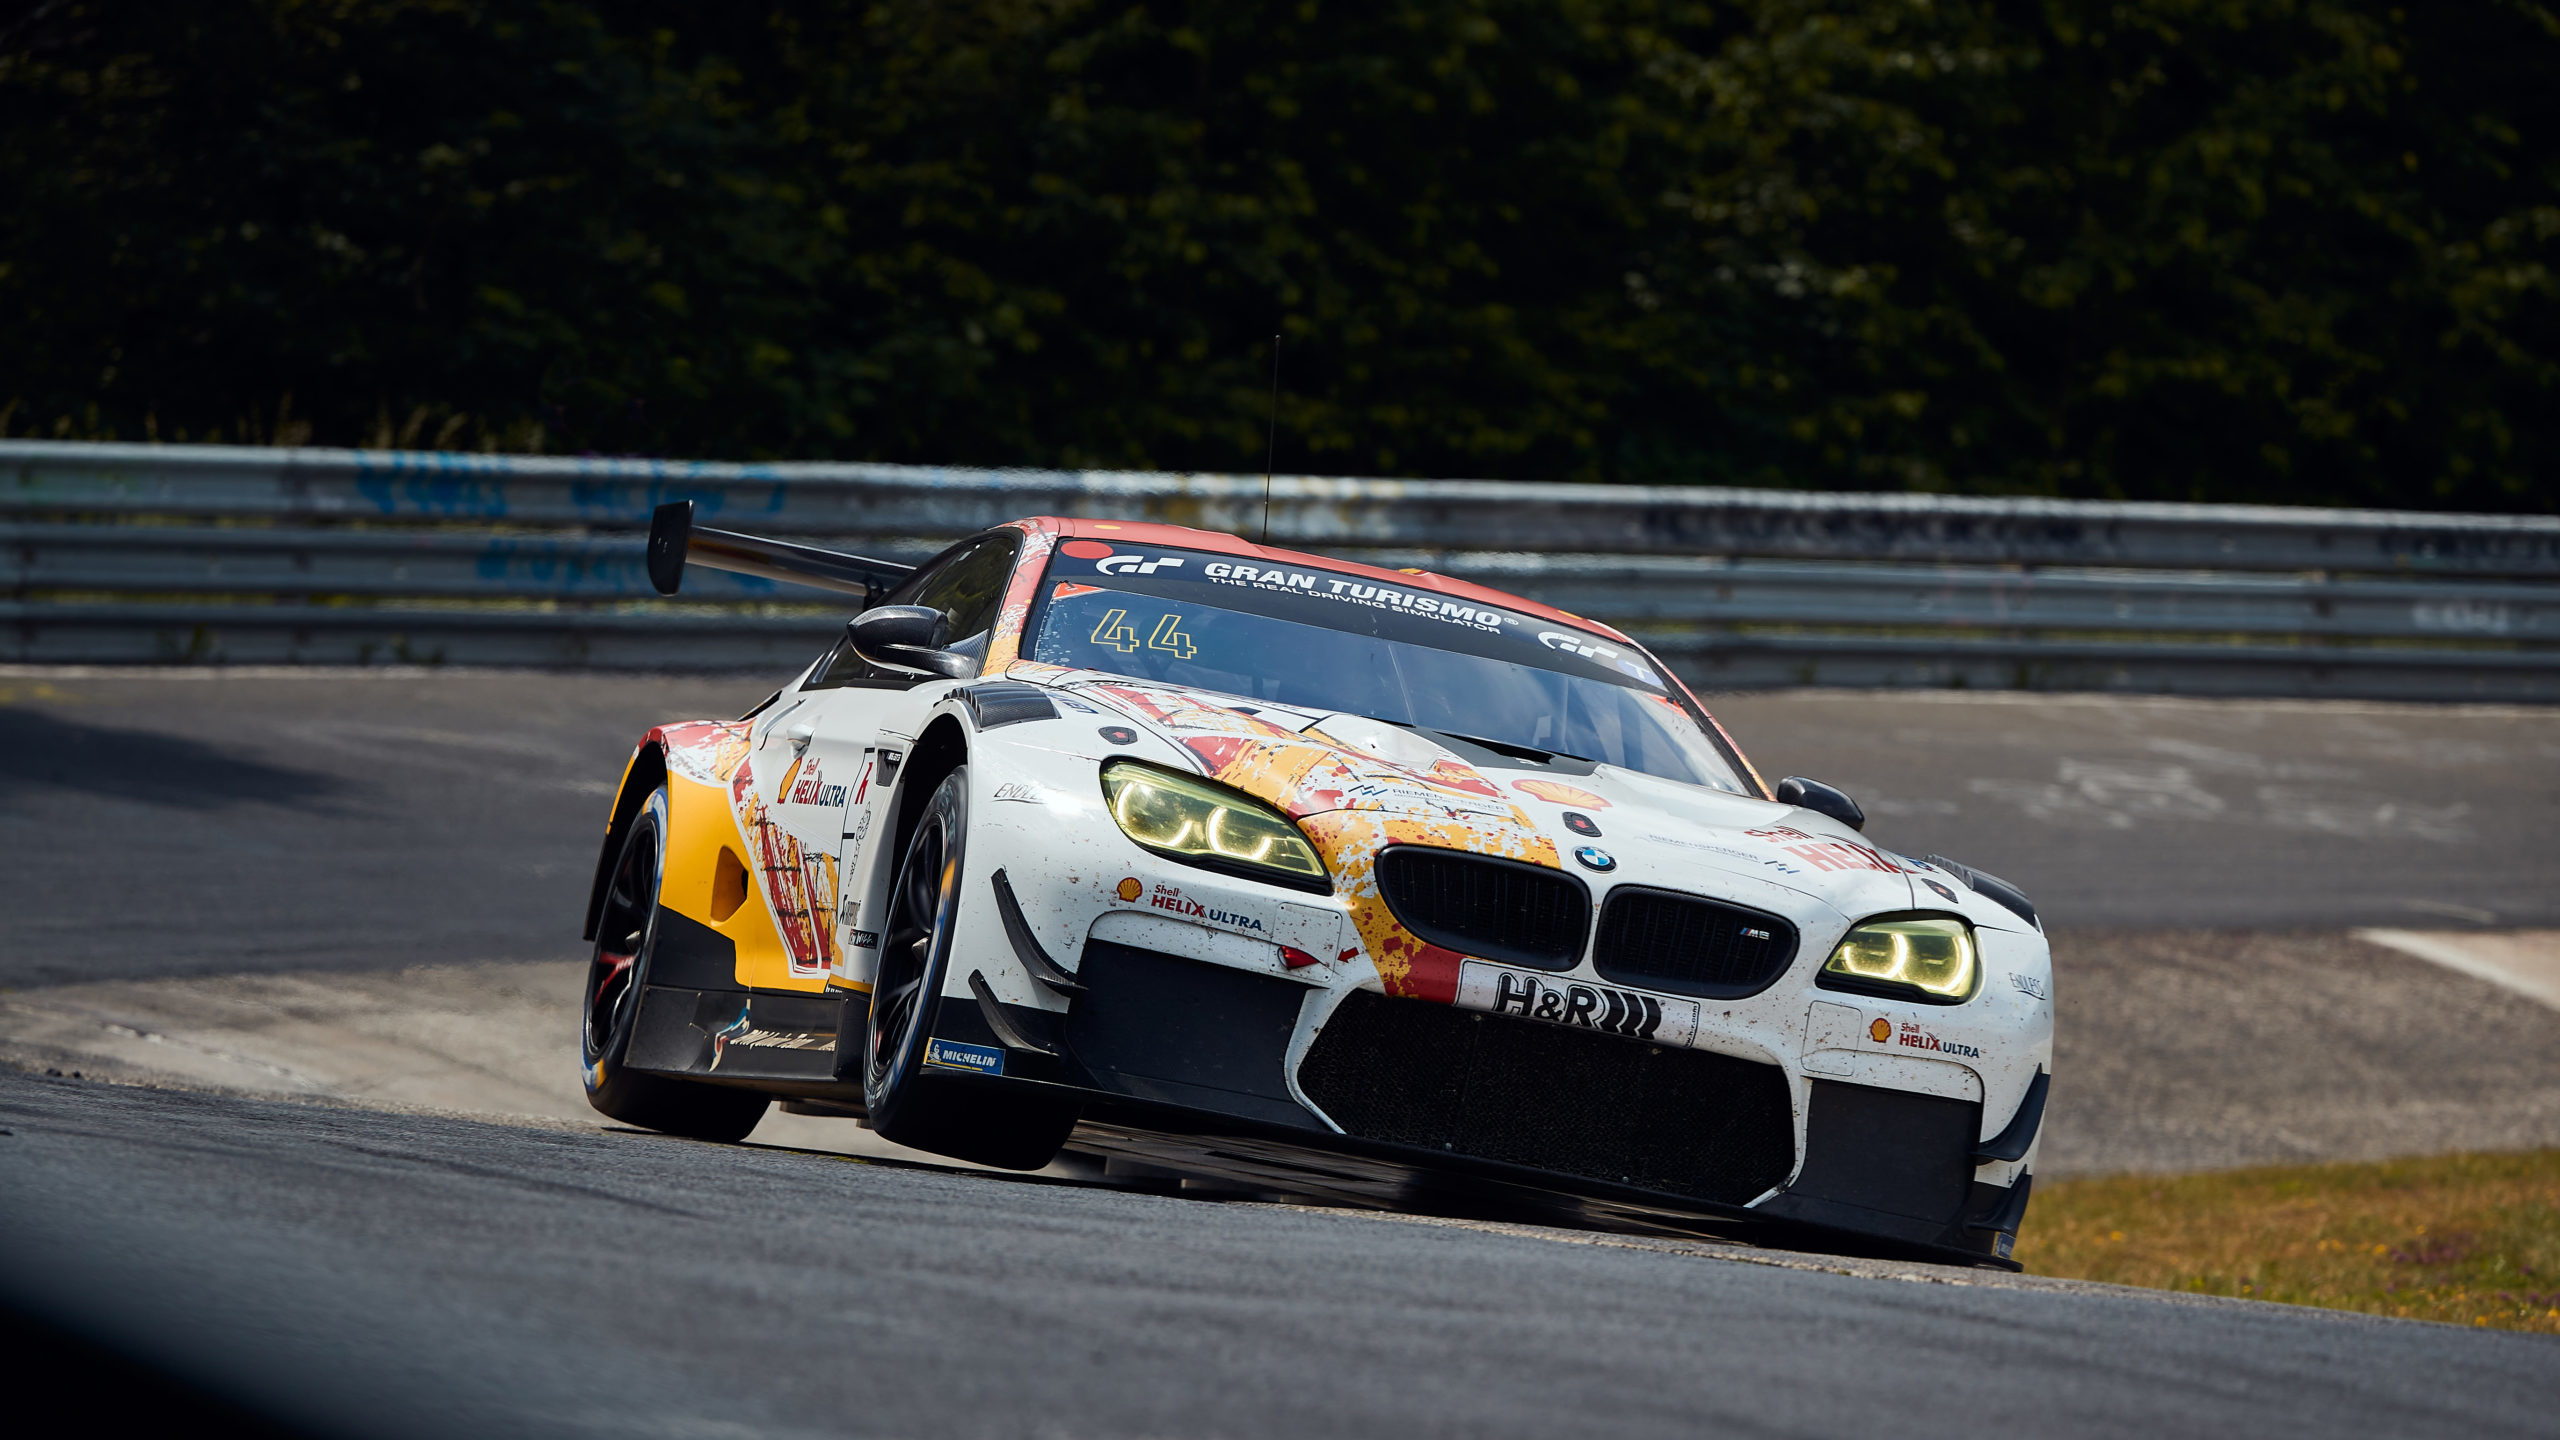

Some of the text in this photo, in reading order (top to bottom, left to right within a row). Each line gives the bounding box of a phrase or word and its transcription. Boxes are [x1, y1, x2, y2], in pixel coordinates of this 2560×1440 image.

[1204, 562, 1316, 589] GRAN
[1208, 577, 1501, 635] THE REAL DRIVING SIMULATOR
[1090, 608, 1198, 660] 44
[792, 769, 823, 805] HELIX
[819, 784, 847, 807] ULTRA
[1154, 884, 1180, 897] Shell
[1151, 895, 1263, 931] HELIX ULTRA
[1494, 974, 1595, 1028] H&R
[1900, 1022, 1920, 1034] Shell
[942, 1049, 997, 1067] MICHELIN
[1899, 1031, 1980, 1058] HELIX ULTRA
